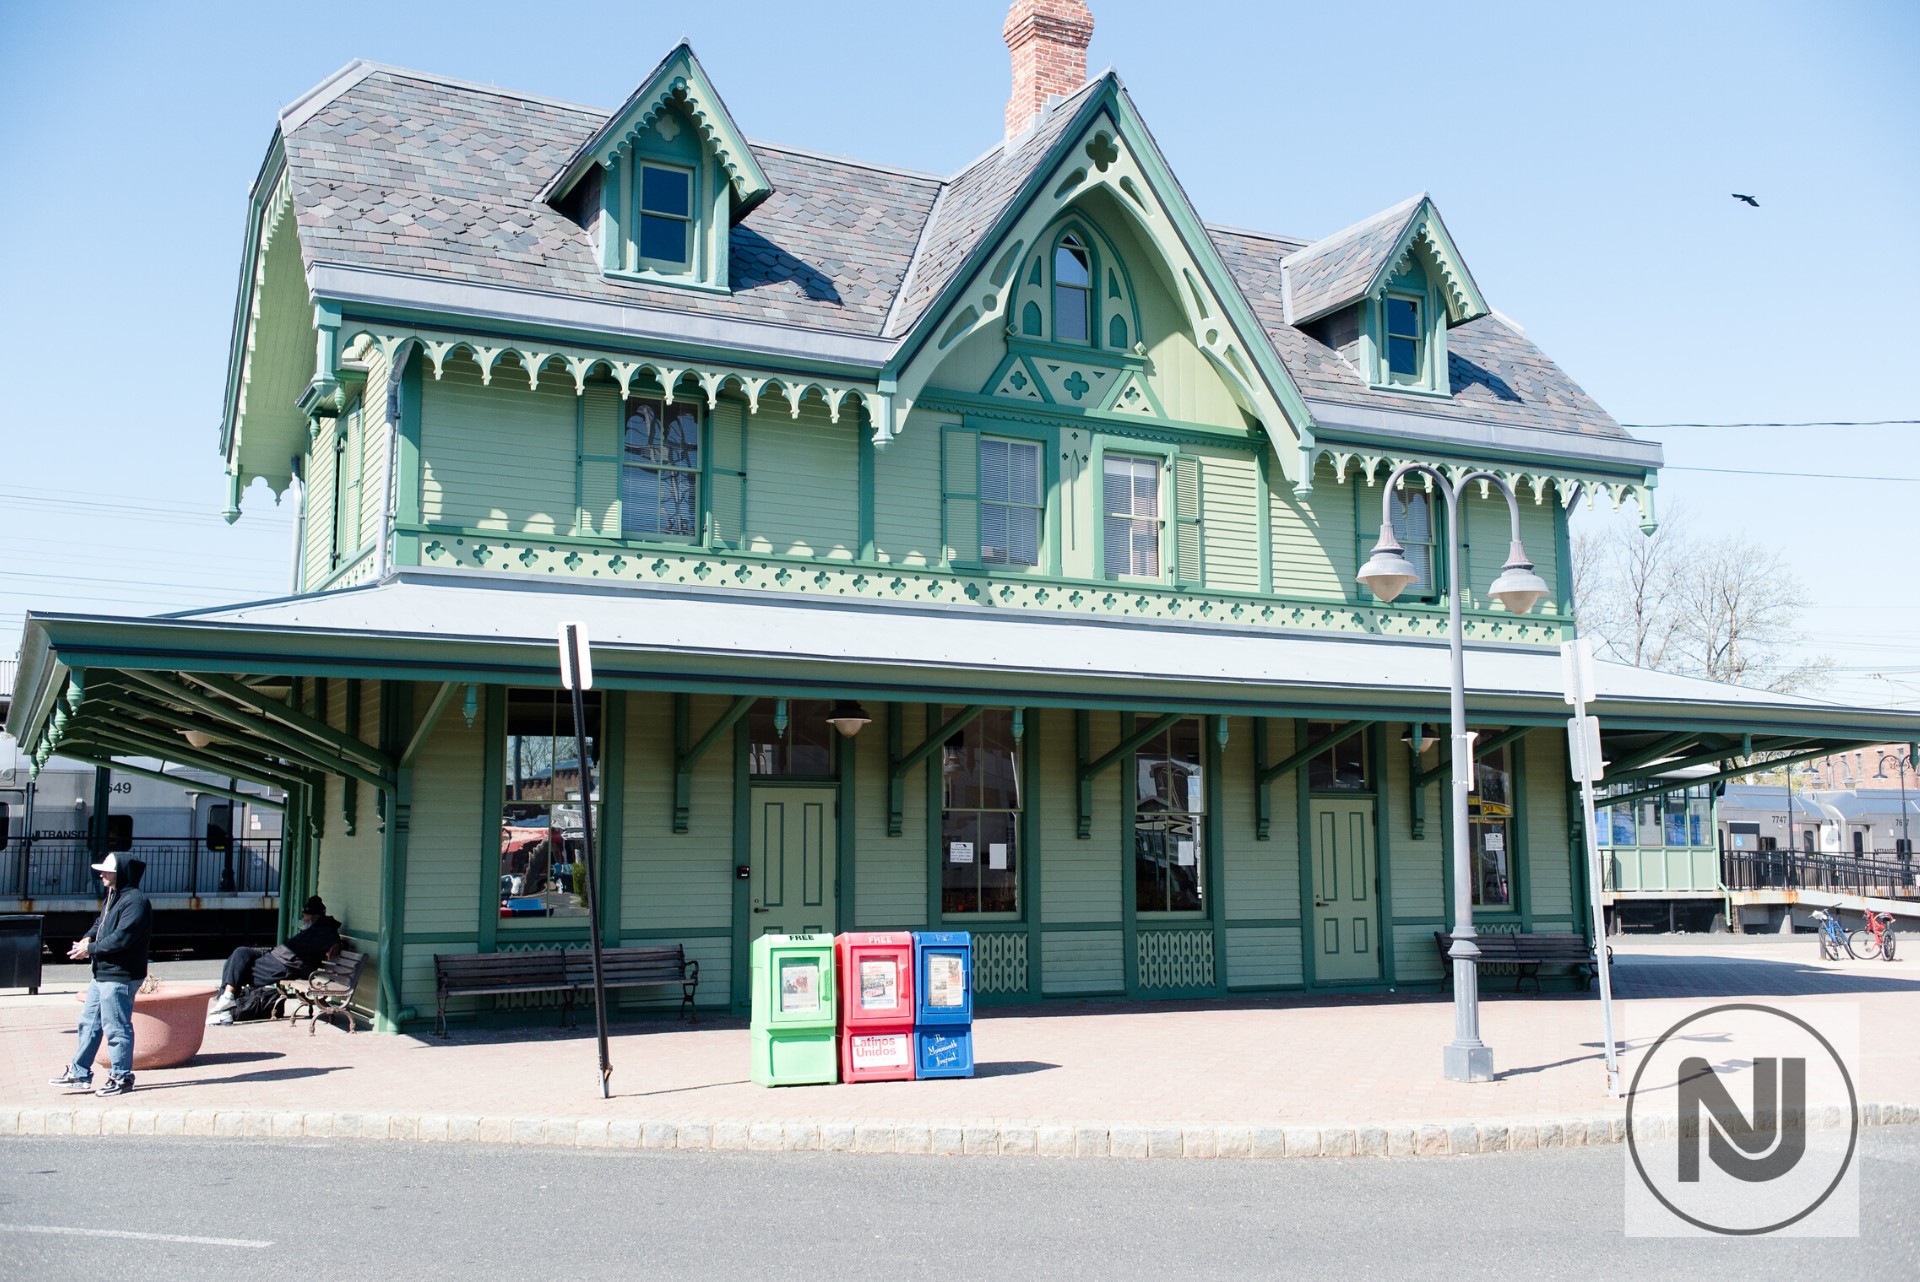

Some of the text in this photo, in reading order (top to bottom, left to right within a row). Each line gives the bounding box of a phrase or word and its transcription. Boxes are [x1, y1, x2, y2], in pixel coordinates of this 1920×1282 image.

[41, 830, 88, 839] TRANSIT
[868, 935, 893, 944] FREE
[853, 1037, 896, 1048] Latinos
[856, 1046, 897, 1058] Unidos
